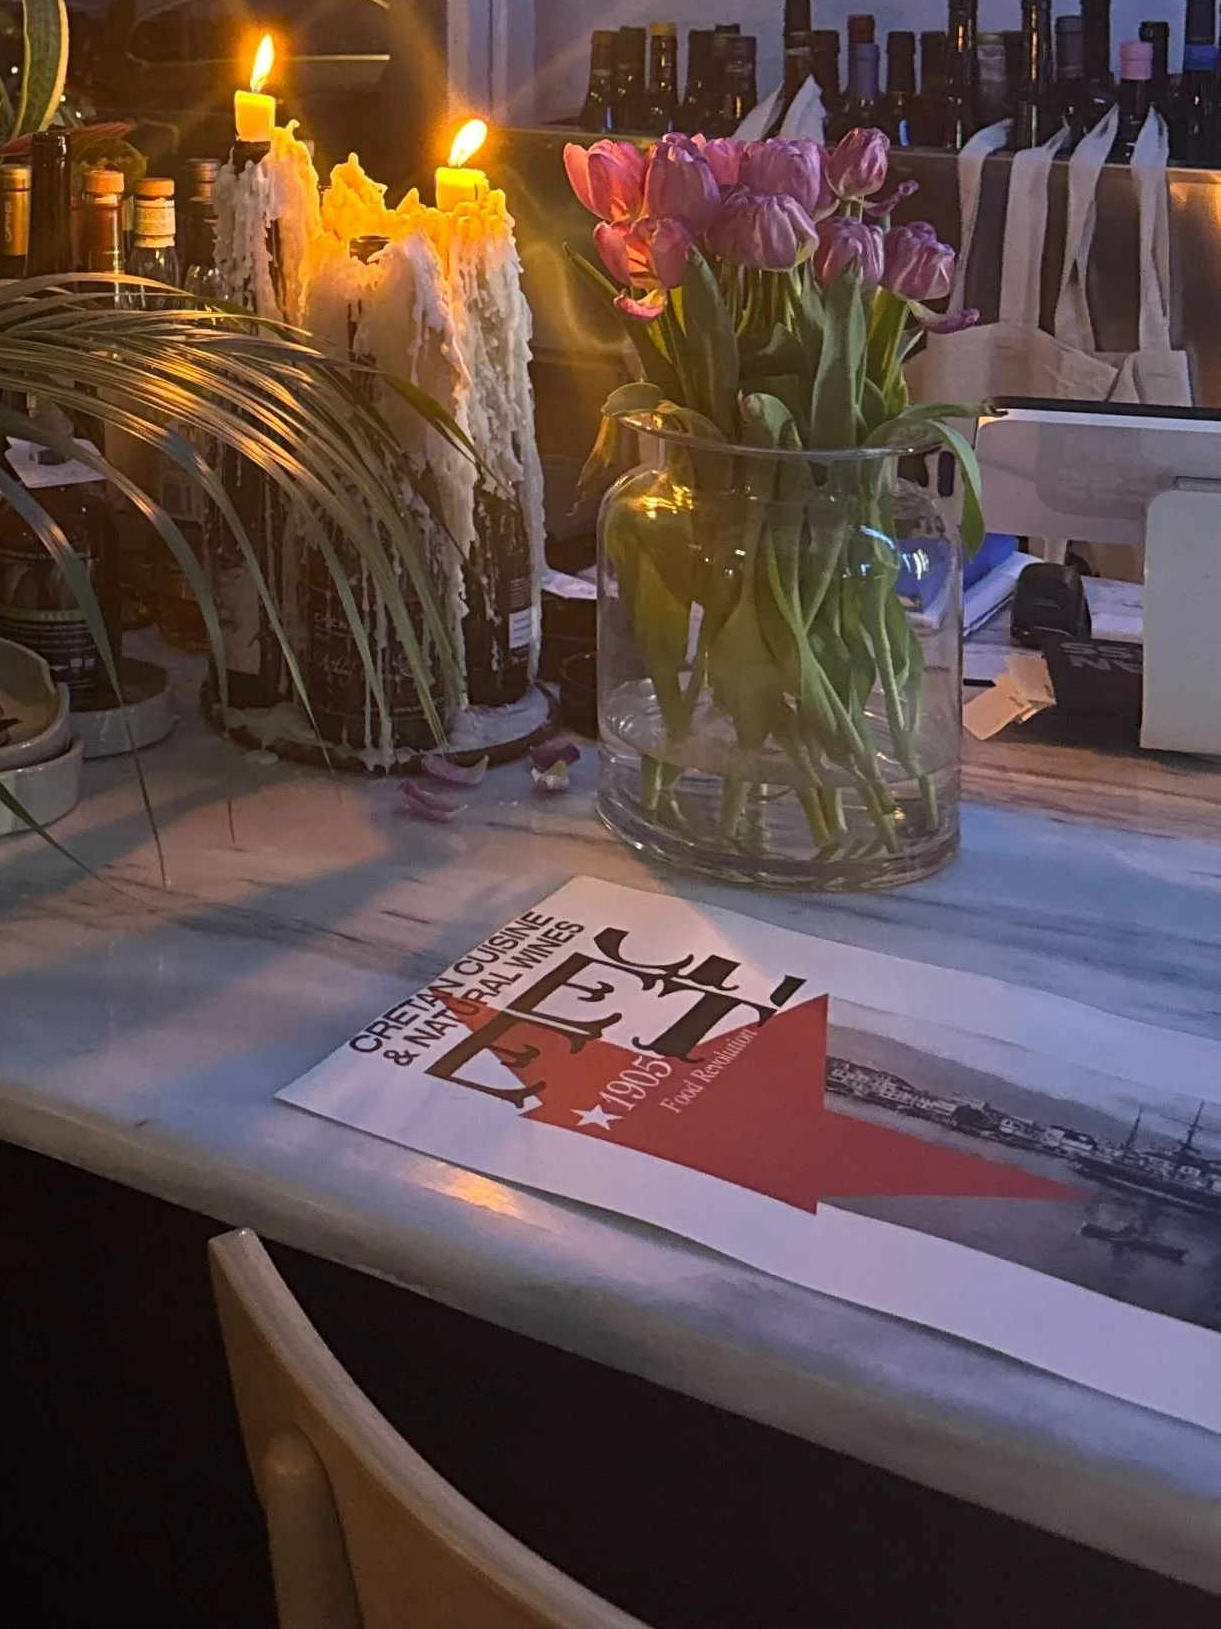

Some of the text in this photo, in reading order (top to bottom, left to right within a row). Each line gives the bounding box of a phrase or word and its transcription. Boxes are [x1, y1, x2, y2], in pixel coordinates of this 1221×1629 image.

[349, 981, 457, 1054] CRETAN
[453, 912, 553, 977] CUISINE
[384, 1045, 420, 1067] &
[410, 968, 521, 1050] NATURAL
[511, 920, 585, 982] WINES
[601, 1054, 673, 1111] 1905
[659, 1028, 757, 1115] Food Revolution
